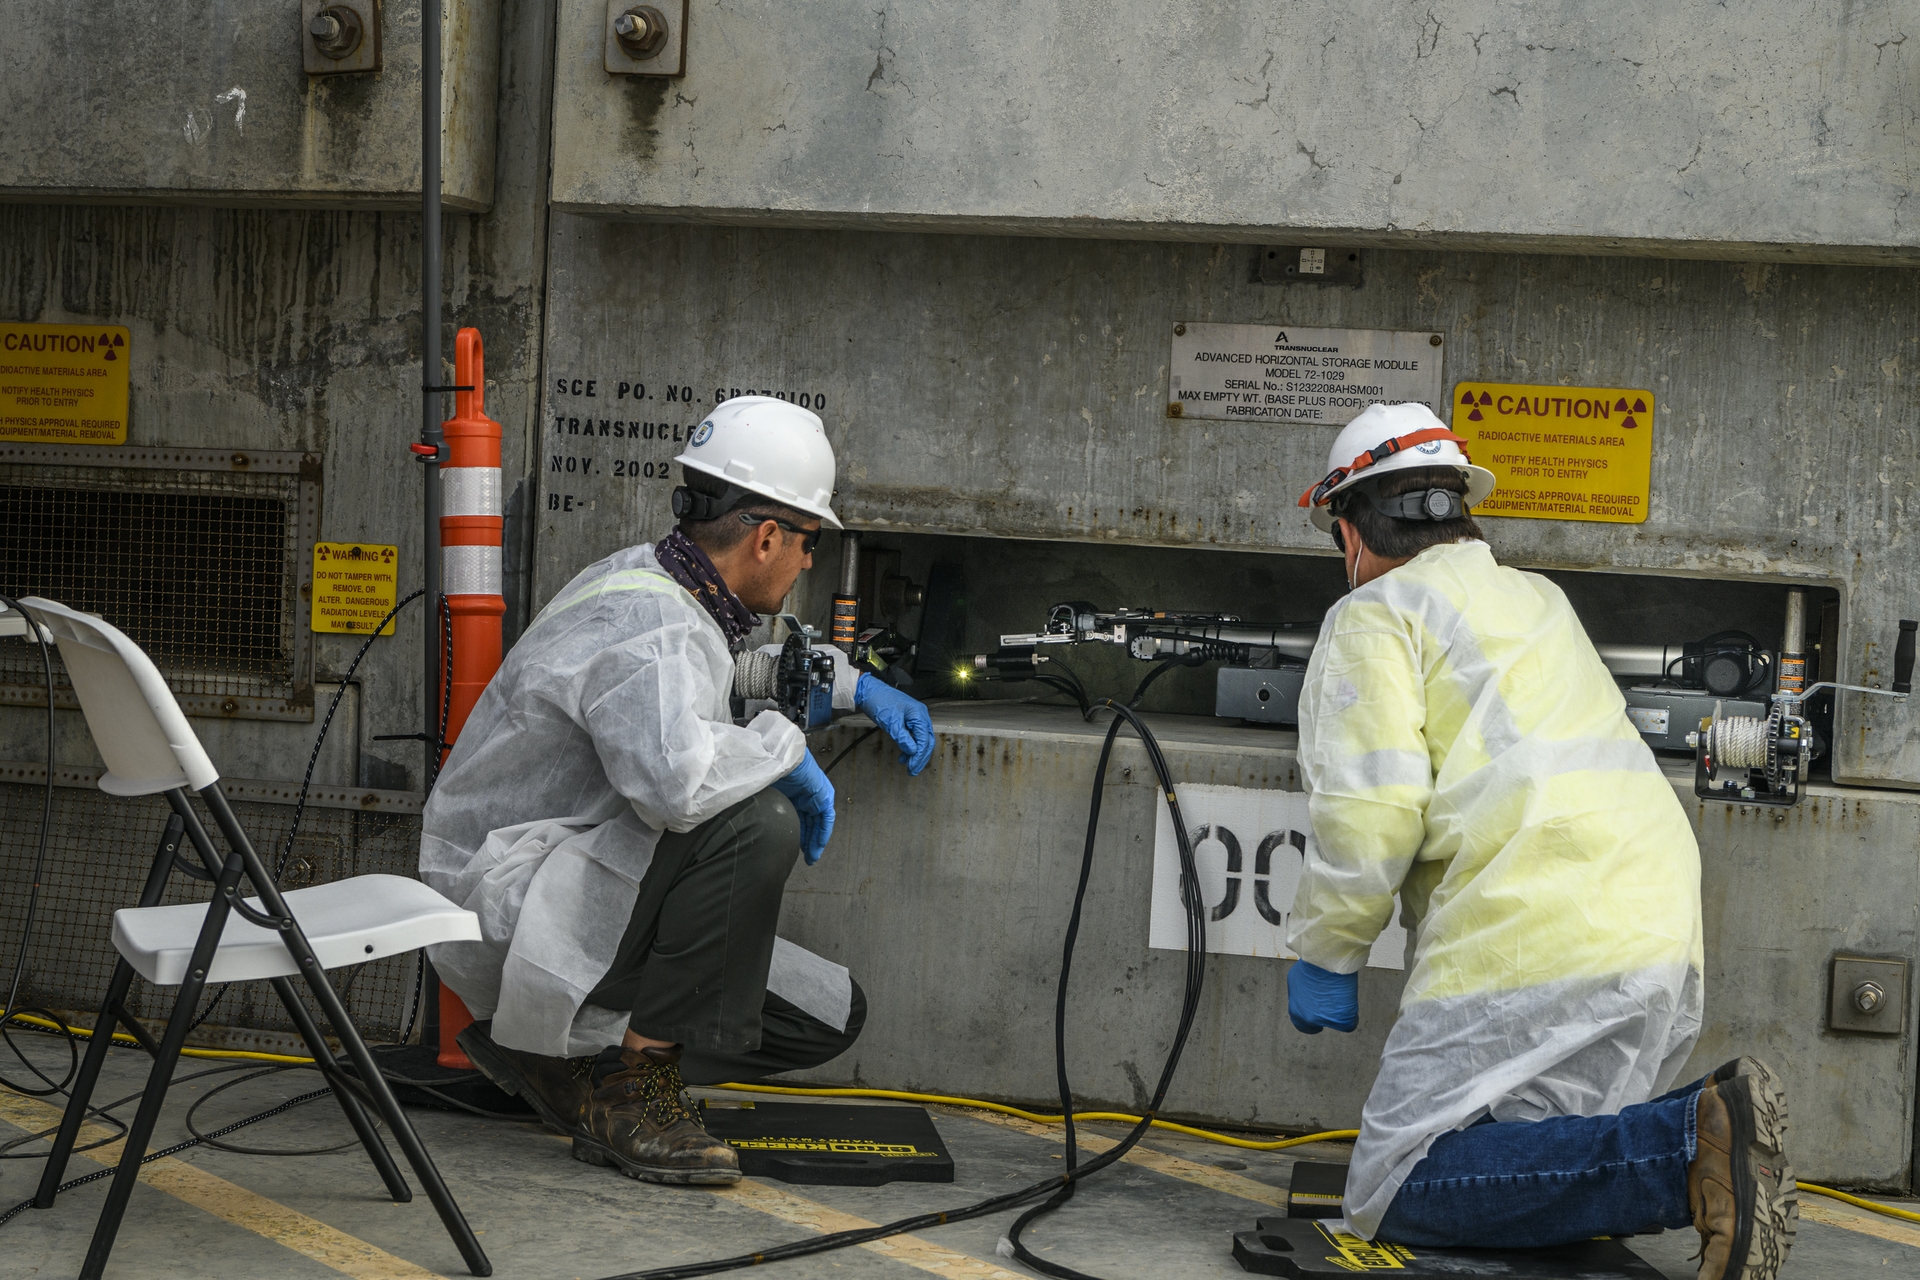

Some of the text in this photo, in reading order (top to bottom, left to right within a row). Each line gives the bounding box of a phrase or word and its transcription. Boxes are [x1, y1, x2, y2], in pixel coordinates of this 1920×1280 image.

[4, 333, 95, 353] CAUTION
[1274, 345, 1339, 353] TRANSNUCLEAR
[1194, 352, 1418, 371] ADVANCED HORIZONTAL STORAGE MODULE
[0, 365, 108, 377] DIOACTIVE MATERIALS AREA
[1265, 368, 1345, 381] MODEL 72-1029
[2, 386, 95, 398] NOTIFY HEALTH PHYSICS
[556, 378, 597, 397] SCE
[618, 382, 654, 400] PO.
[667, 384, 701, 403] NO.
[1224, 379, 1261, 390] SERIAL
[1286, 382, 1384, 396] S1232208AHSM001
[16, 397, 79, 407] PRIOR TO ENTRY
[1178, 390, 1201, 401] MAX
[1203, 391, 1240, 402] EMPTY
[1243, 393, 1262, 404] WT.
[1264, 394, 1296, 406] (BASE
[1298, 395, 1327, 406] PLUS
[1329, 396, 1365, 409] ROOF):
[1226, 405, 1294, 418] FABRICATION
[1295, 407, 1323, 419] DATE:
[1497, 395, 1610, 420] CAUTION
[5, 416, 37, 426] PHYSICS
[39, 418, 79, 428] APPROVAL
[81, 420, 121, 429] REQUIRED
[555, 416, 697, 442] TRANSNUCLE
[0, 426, 116, 439] QUIPMENT/MATERIAL REMOVAL
[1478, 430, 1626, 447] RADIOACTIVE MATERIALS AREA
[552, 455, 670, 479] NOV. 2002
[1492, 454, 1608, 469] NOTIFY HEALTH PHYSICS
[1510, 468, 1589, 479] PRIOR TO ENTRY
[1496, 489, 1537, 500] PHYSICS
[1538, 491, 1589, 503] APPROVAL
[1591, 494, 1640, 505] REQUIRED
[1483, 500, 1635, 517] EQUIPMENT/MATERIAL REMOVAL
[316, 571, 327, 579] DO
[344, 572, 372, 581] TAMPER
[373, 574, 393, 583] WITH,
[333, 584, 376, 593] REMOVE, OR
[318, 596, 389, 606] ALTER. DANGEROUS
[321, 608, 386, 618] RADIATION LEVELS
[347, 621, 374, 630] ESULT.
